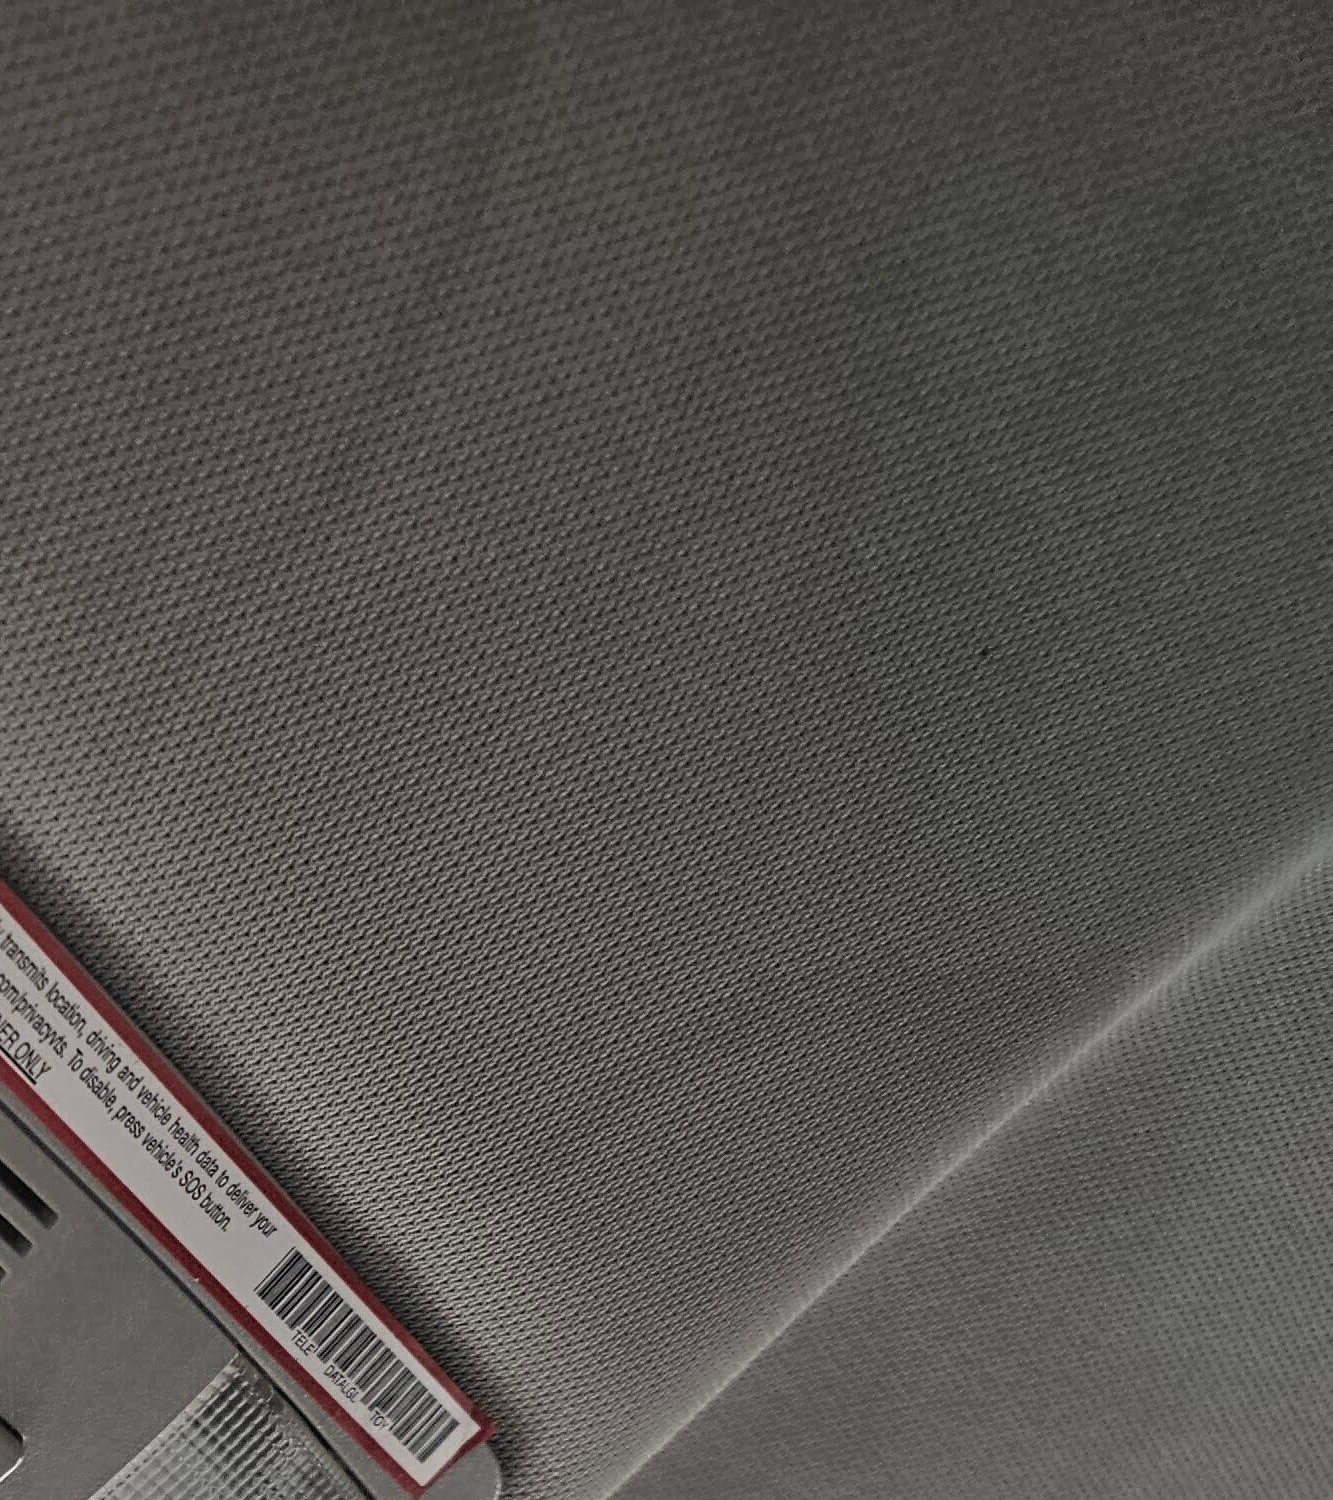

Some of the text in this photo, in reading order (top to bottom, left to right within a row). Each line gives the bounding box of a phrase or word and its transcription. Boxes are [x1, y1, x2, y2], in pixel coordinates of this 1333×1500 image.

[11, 1039, 52, 1082] ONLY
[63, 1047, 88, 1073] To
[75, 1062, 124, 1114] disable,
[40, 981, 94, 1039] location,
[80, 1026, 125, 1075] driving
[115, 1061, 144, 1092] and
[134, 1081, 176, 1127] vehicle
[166, 1116, 204, 1157] health
[193, 1147, 223, 1178] data
[213, 1169, 232, 1189] to
[223, 1179, 261, 1219] deliver
[248, 1211, 278, 1243] your
[110, 1103, 147, 1143] press
[139, 1128, 186, 1179] vehicle's
[176, 1168, 208, 1202] SOS
[198, 1191, 237, 1233] button.
